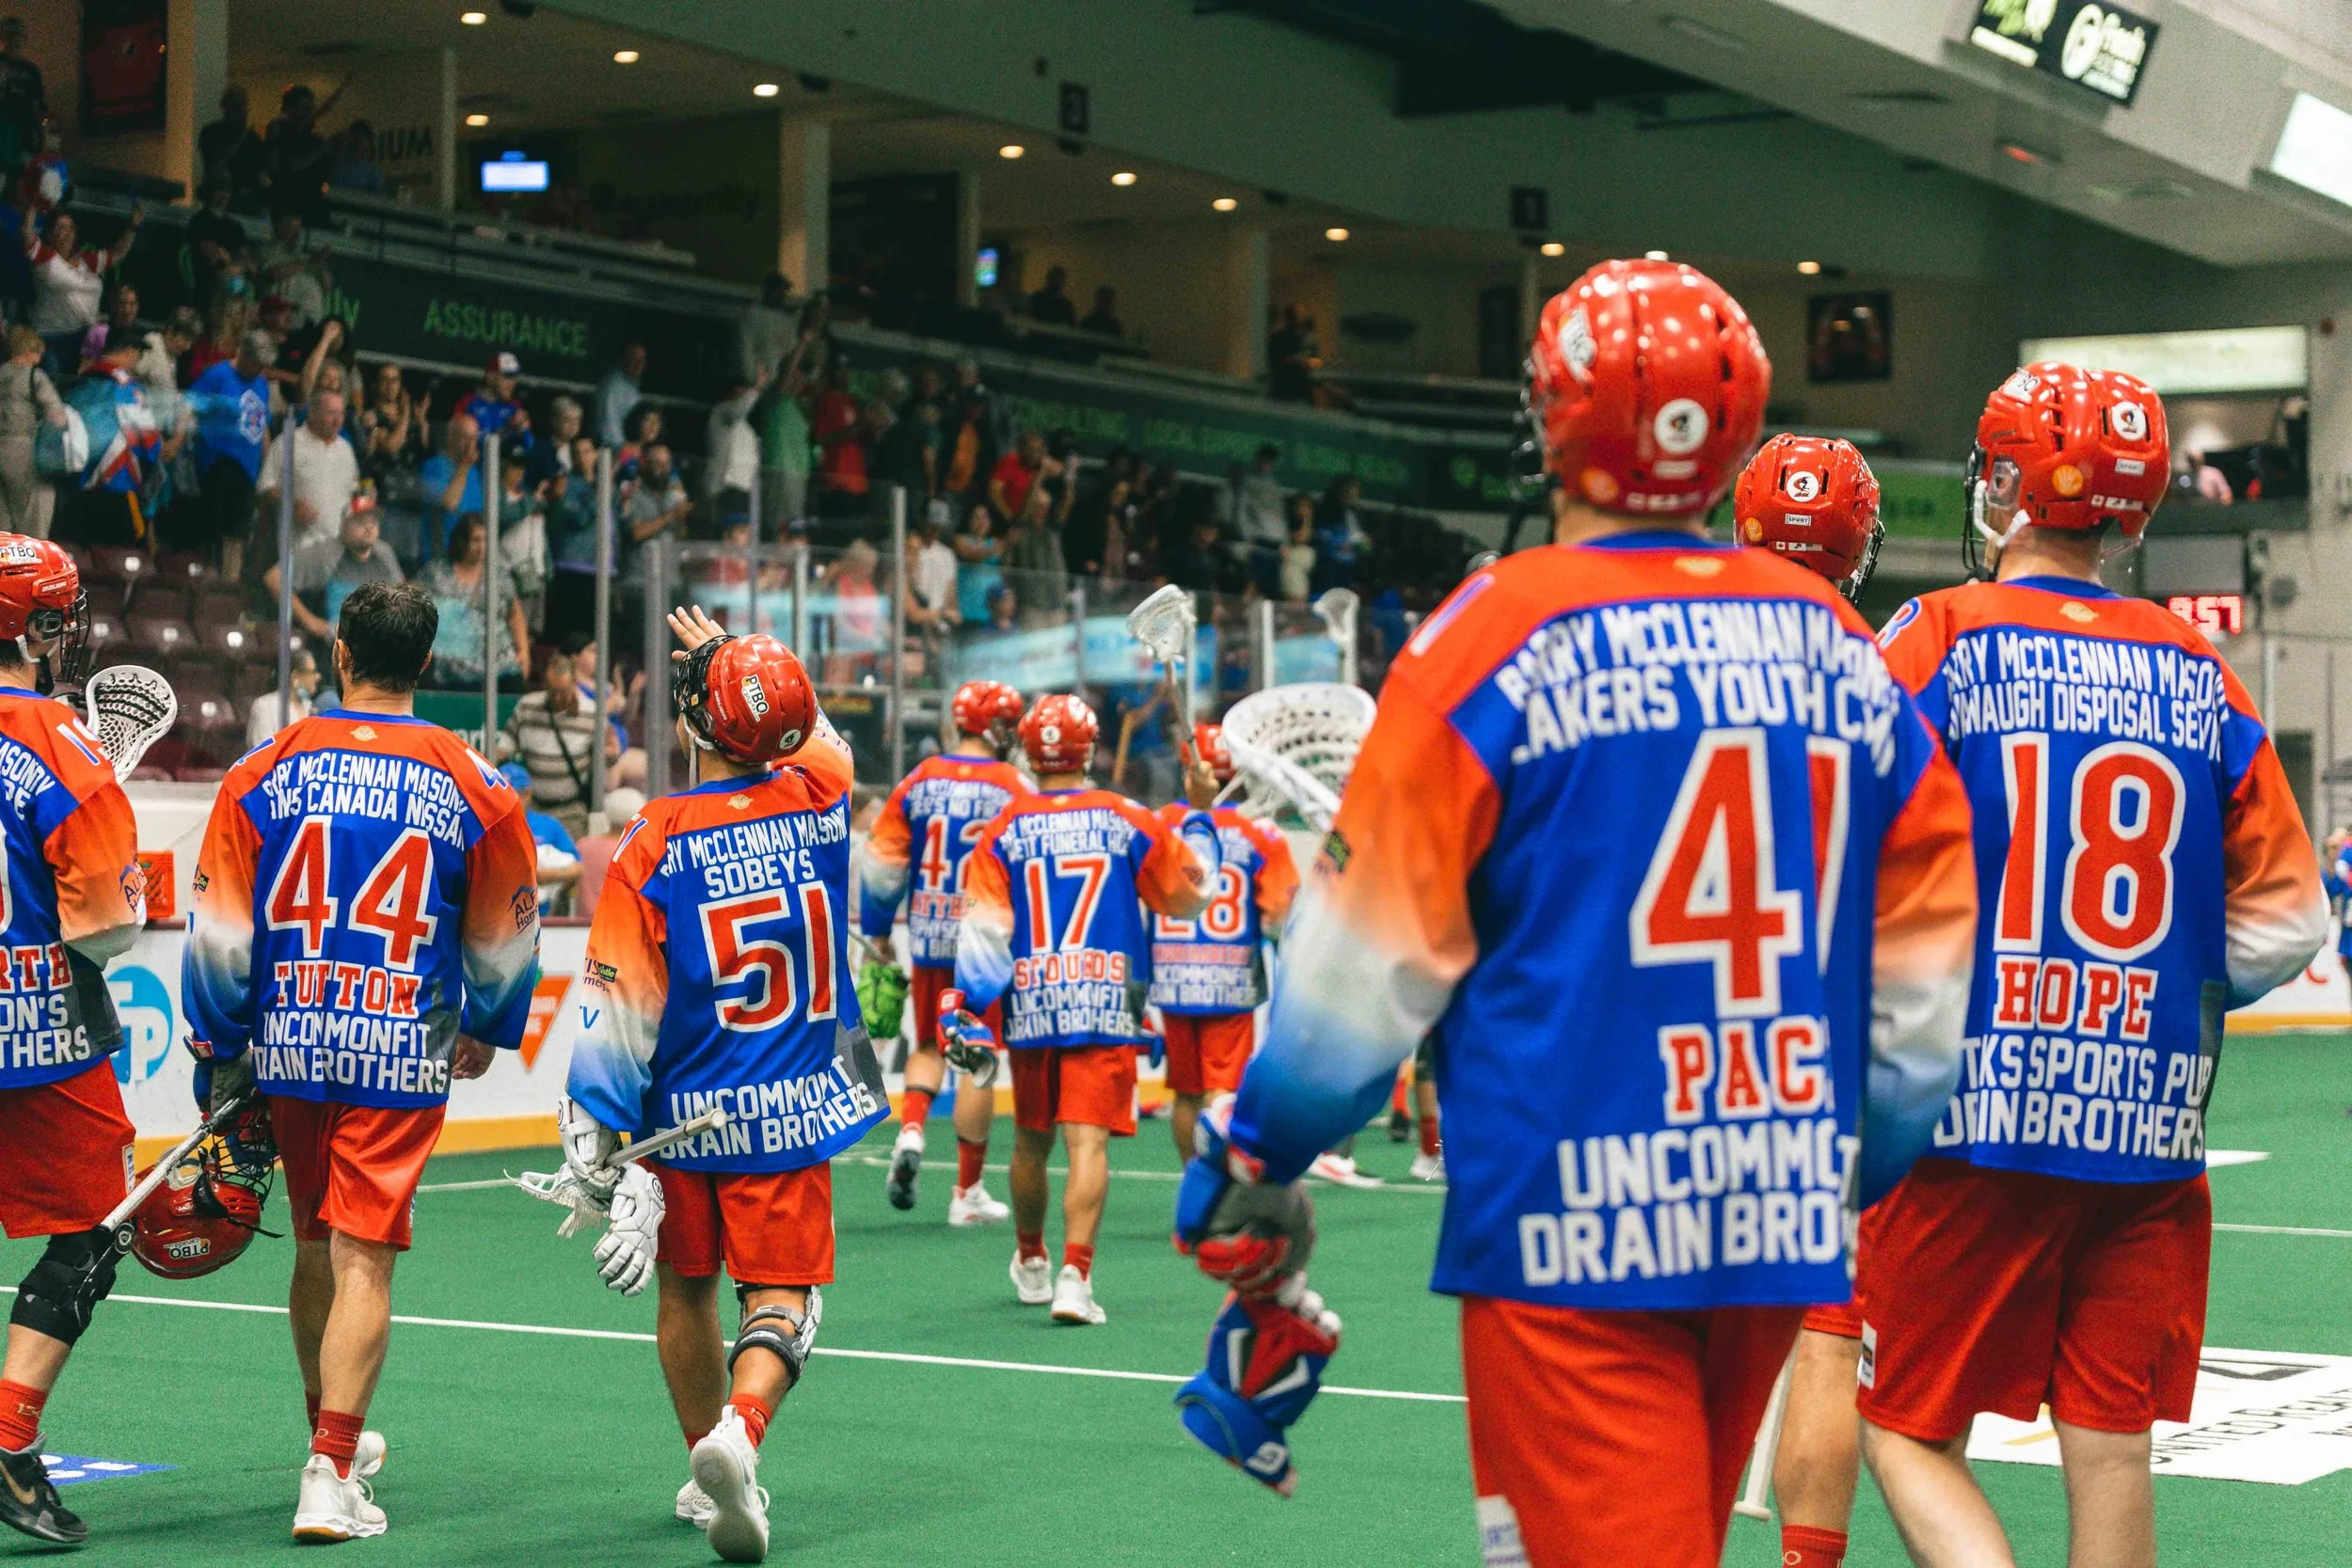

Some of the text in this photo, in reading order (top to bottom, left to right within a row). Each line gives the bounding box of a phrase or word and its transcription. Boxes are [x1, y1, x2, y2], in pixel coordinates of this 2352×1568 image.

[422, 298, 589, 358] ASSURANCE
[745, 675, 769, 713] PTBO
[1510, 661, 1680, 766] AKERS
[2052, 682, 2167, 745] DISPOSAL
[307, 781, 398, 822] CANADA
[704, 848, 816, 899] SOBEYS
[1041, 830, 1106, 857] FUNERAL
[1994, 730, 2187, 963] 18
[264, 815, 439, 973] 44
[1023, 851, 1112, 955] 17
[697, 880, 837, 1034] 51
[1992, 954, 2159, 1042] HOPE
[2026, 1036, 2157, 1102] SPORTS
[2022, 1090, 2205, 1162] BROTHERS
[169, 1243, 210, 1259] PTBO
[1518, 1200, 1713, 1287] DRAIN
